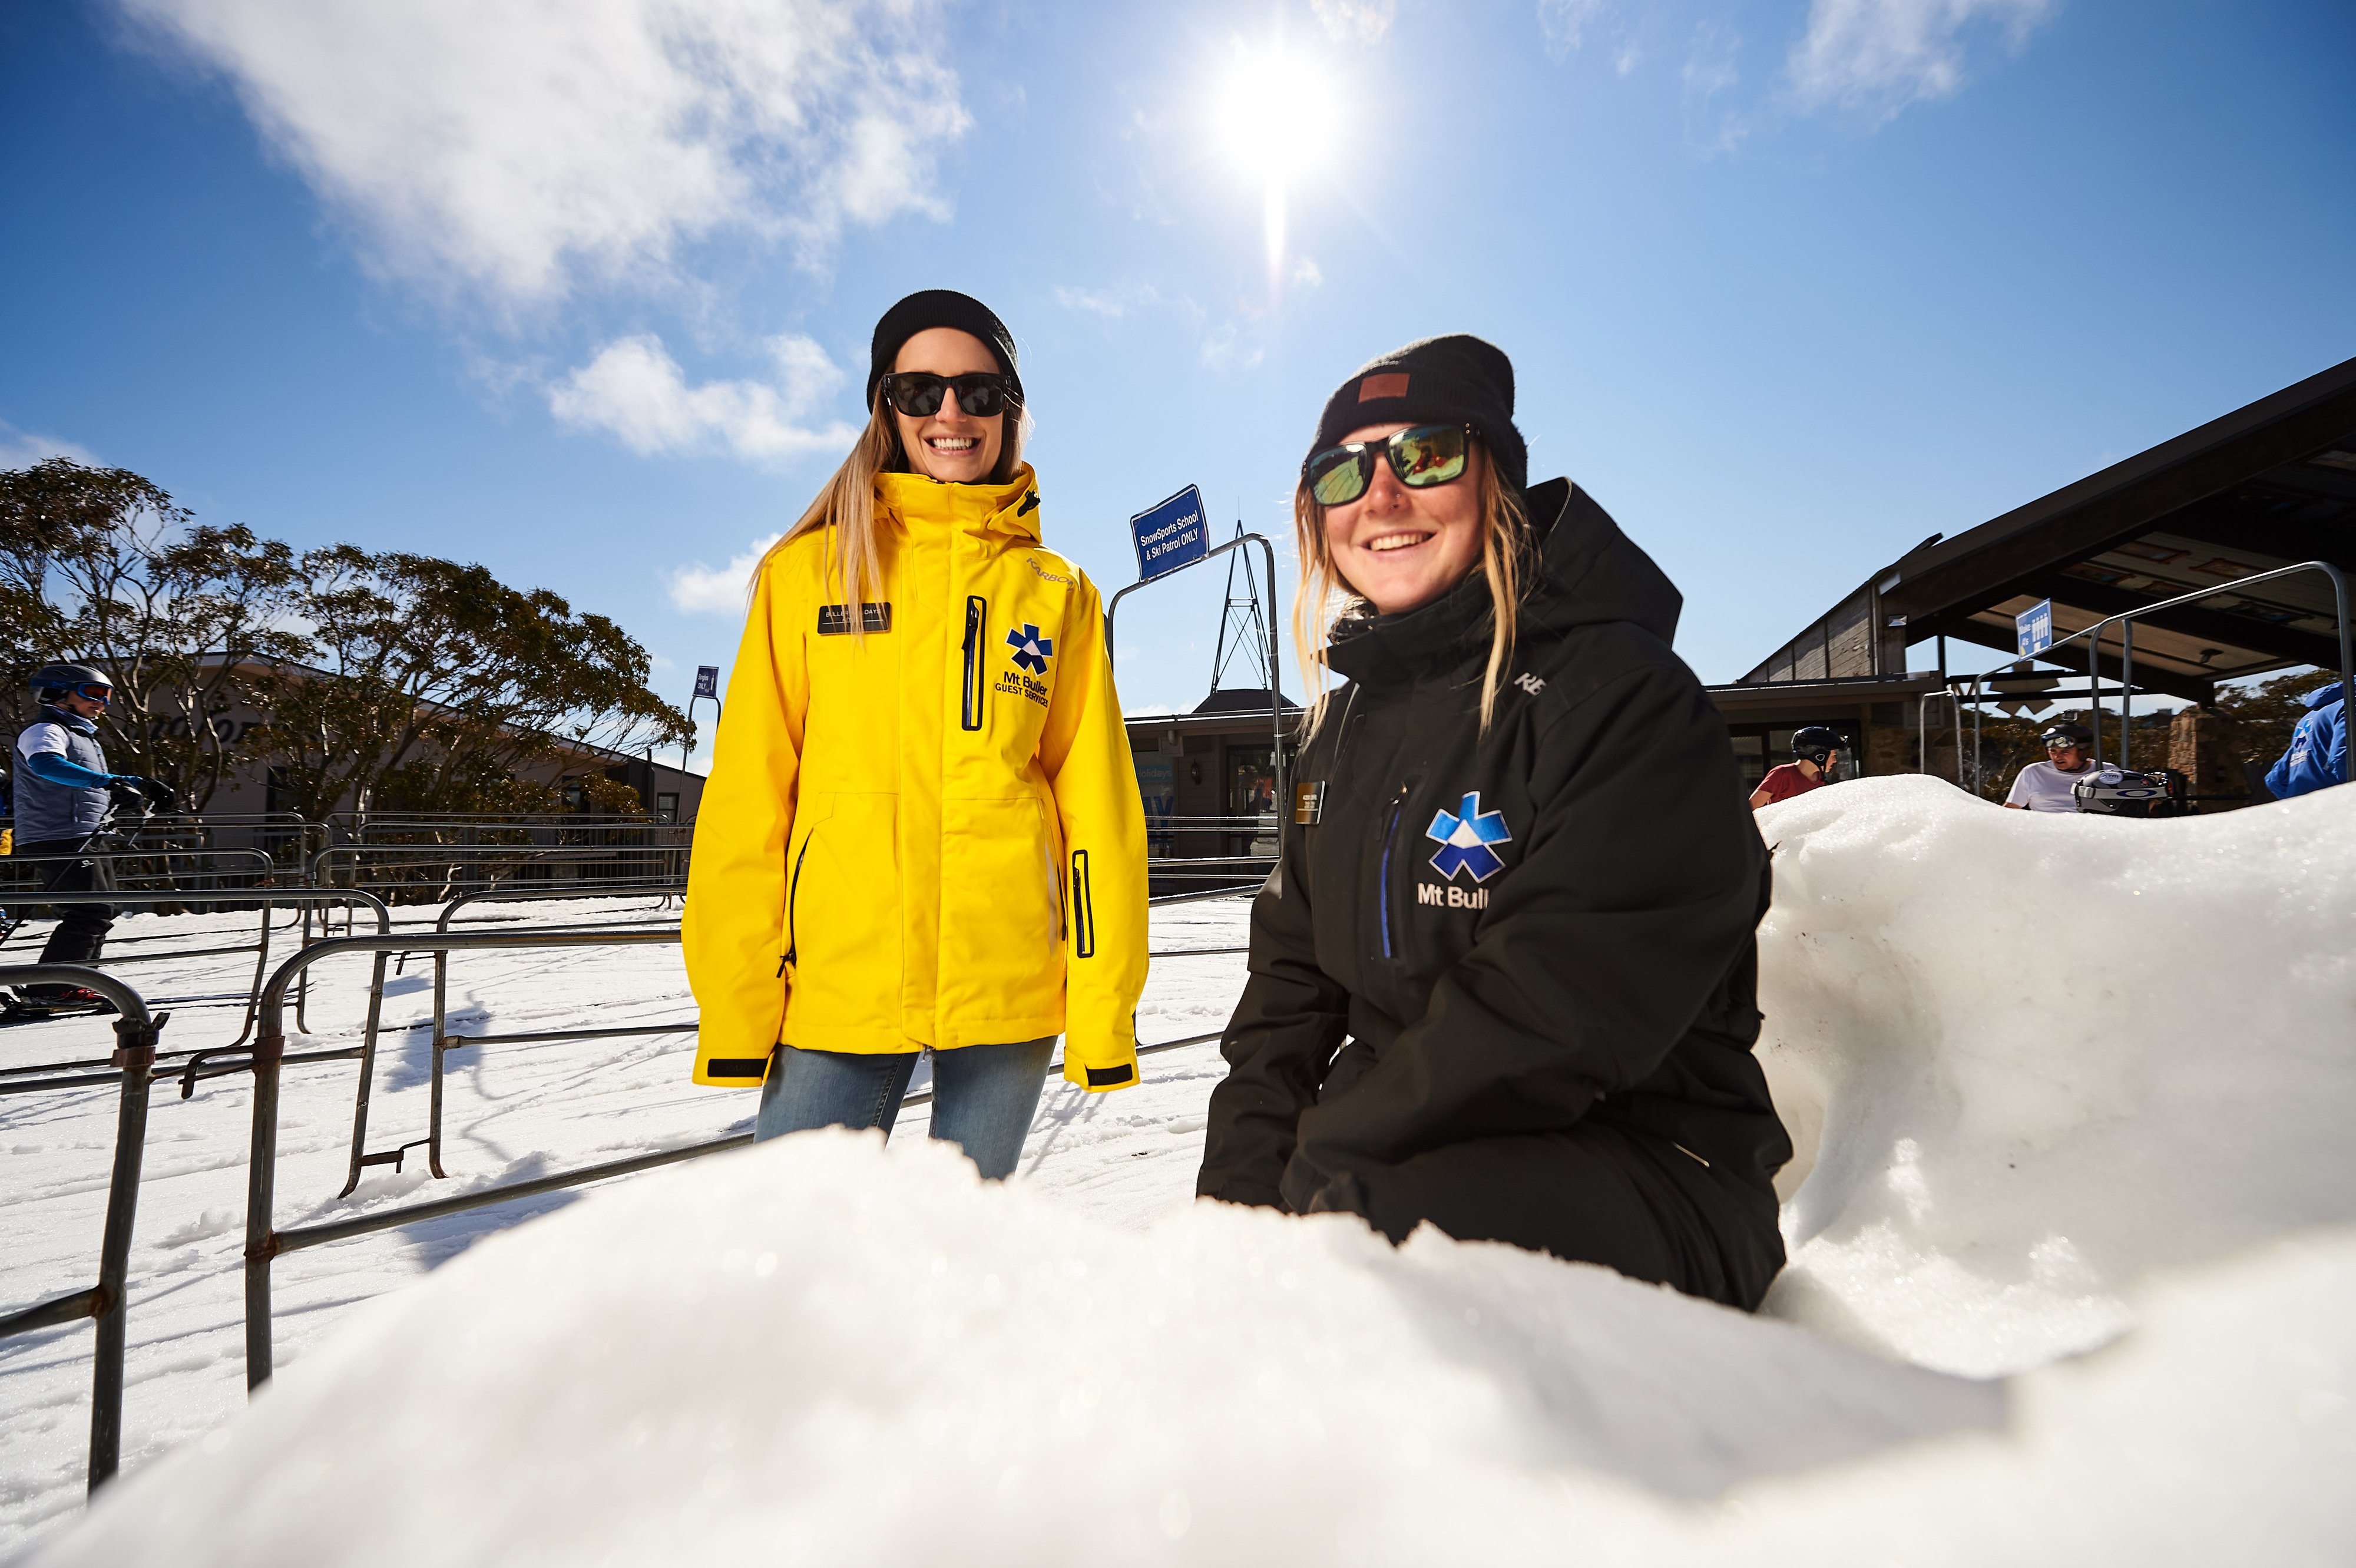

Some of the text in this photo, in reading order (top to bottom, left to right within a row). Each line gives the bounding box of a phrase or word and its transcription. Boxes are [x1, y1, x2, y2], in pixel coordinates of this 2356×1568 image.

[1140, 510, 1199, 547] SnowSports School
[1146, 528, 1199, 561] & Ski Patrol ONLY
[995, 683, 1048, 708] GUEST SERVICES
[1004, 671, 1048, 697] Mt Buller
[1417, 882, 1444, 907] Mt
